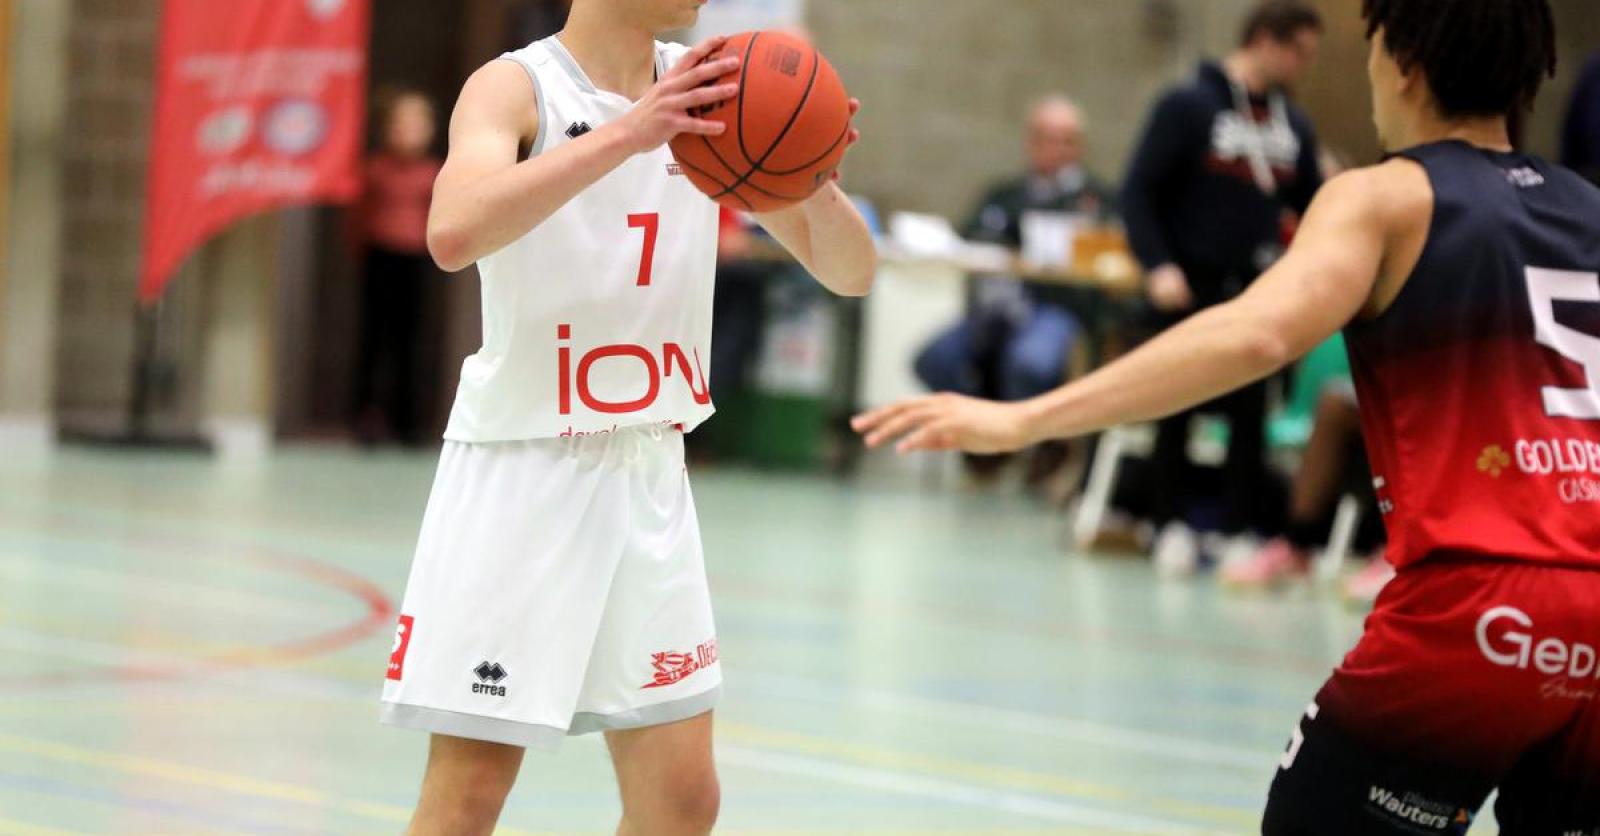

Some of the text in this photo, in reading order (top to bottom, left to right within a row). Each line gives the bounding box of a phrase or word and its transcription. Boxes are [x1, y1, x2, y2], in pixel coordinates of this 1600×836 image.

[627, 212, 659, 286] 7
[1524, 265, 1600, 421] 5
[1368, 784, 1449, 829] Wauters
